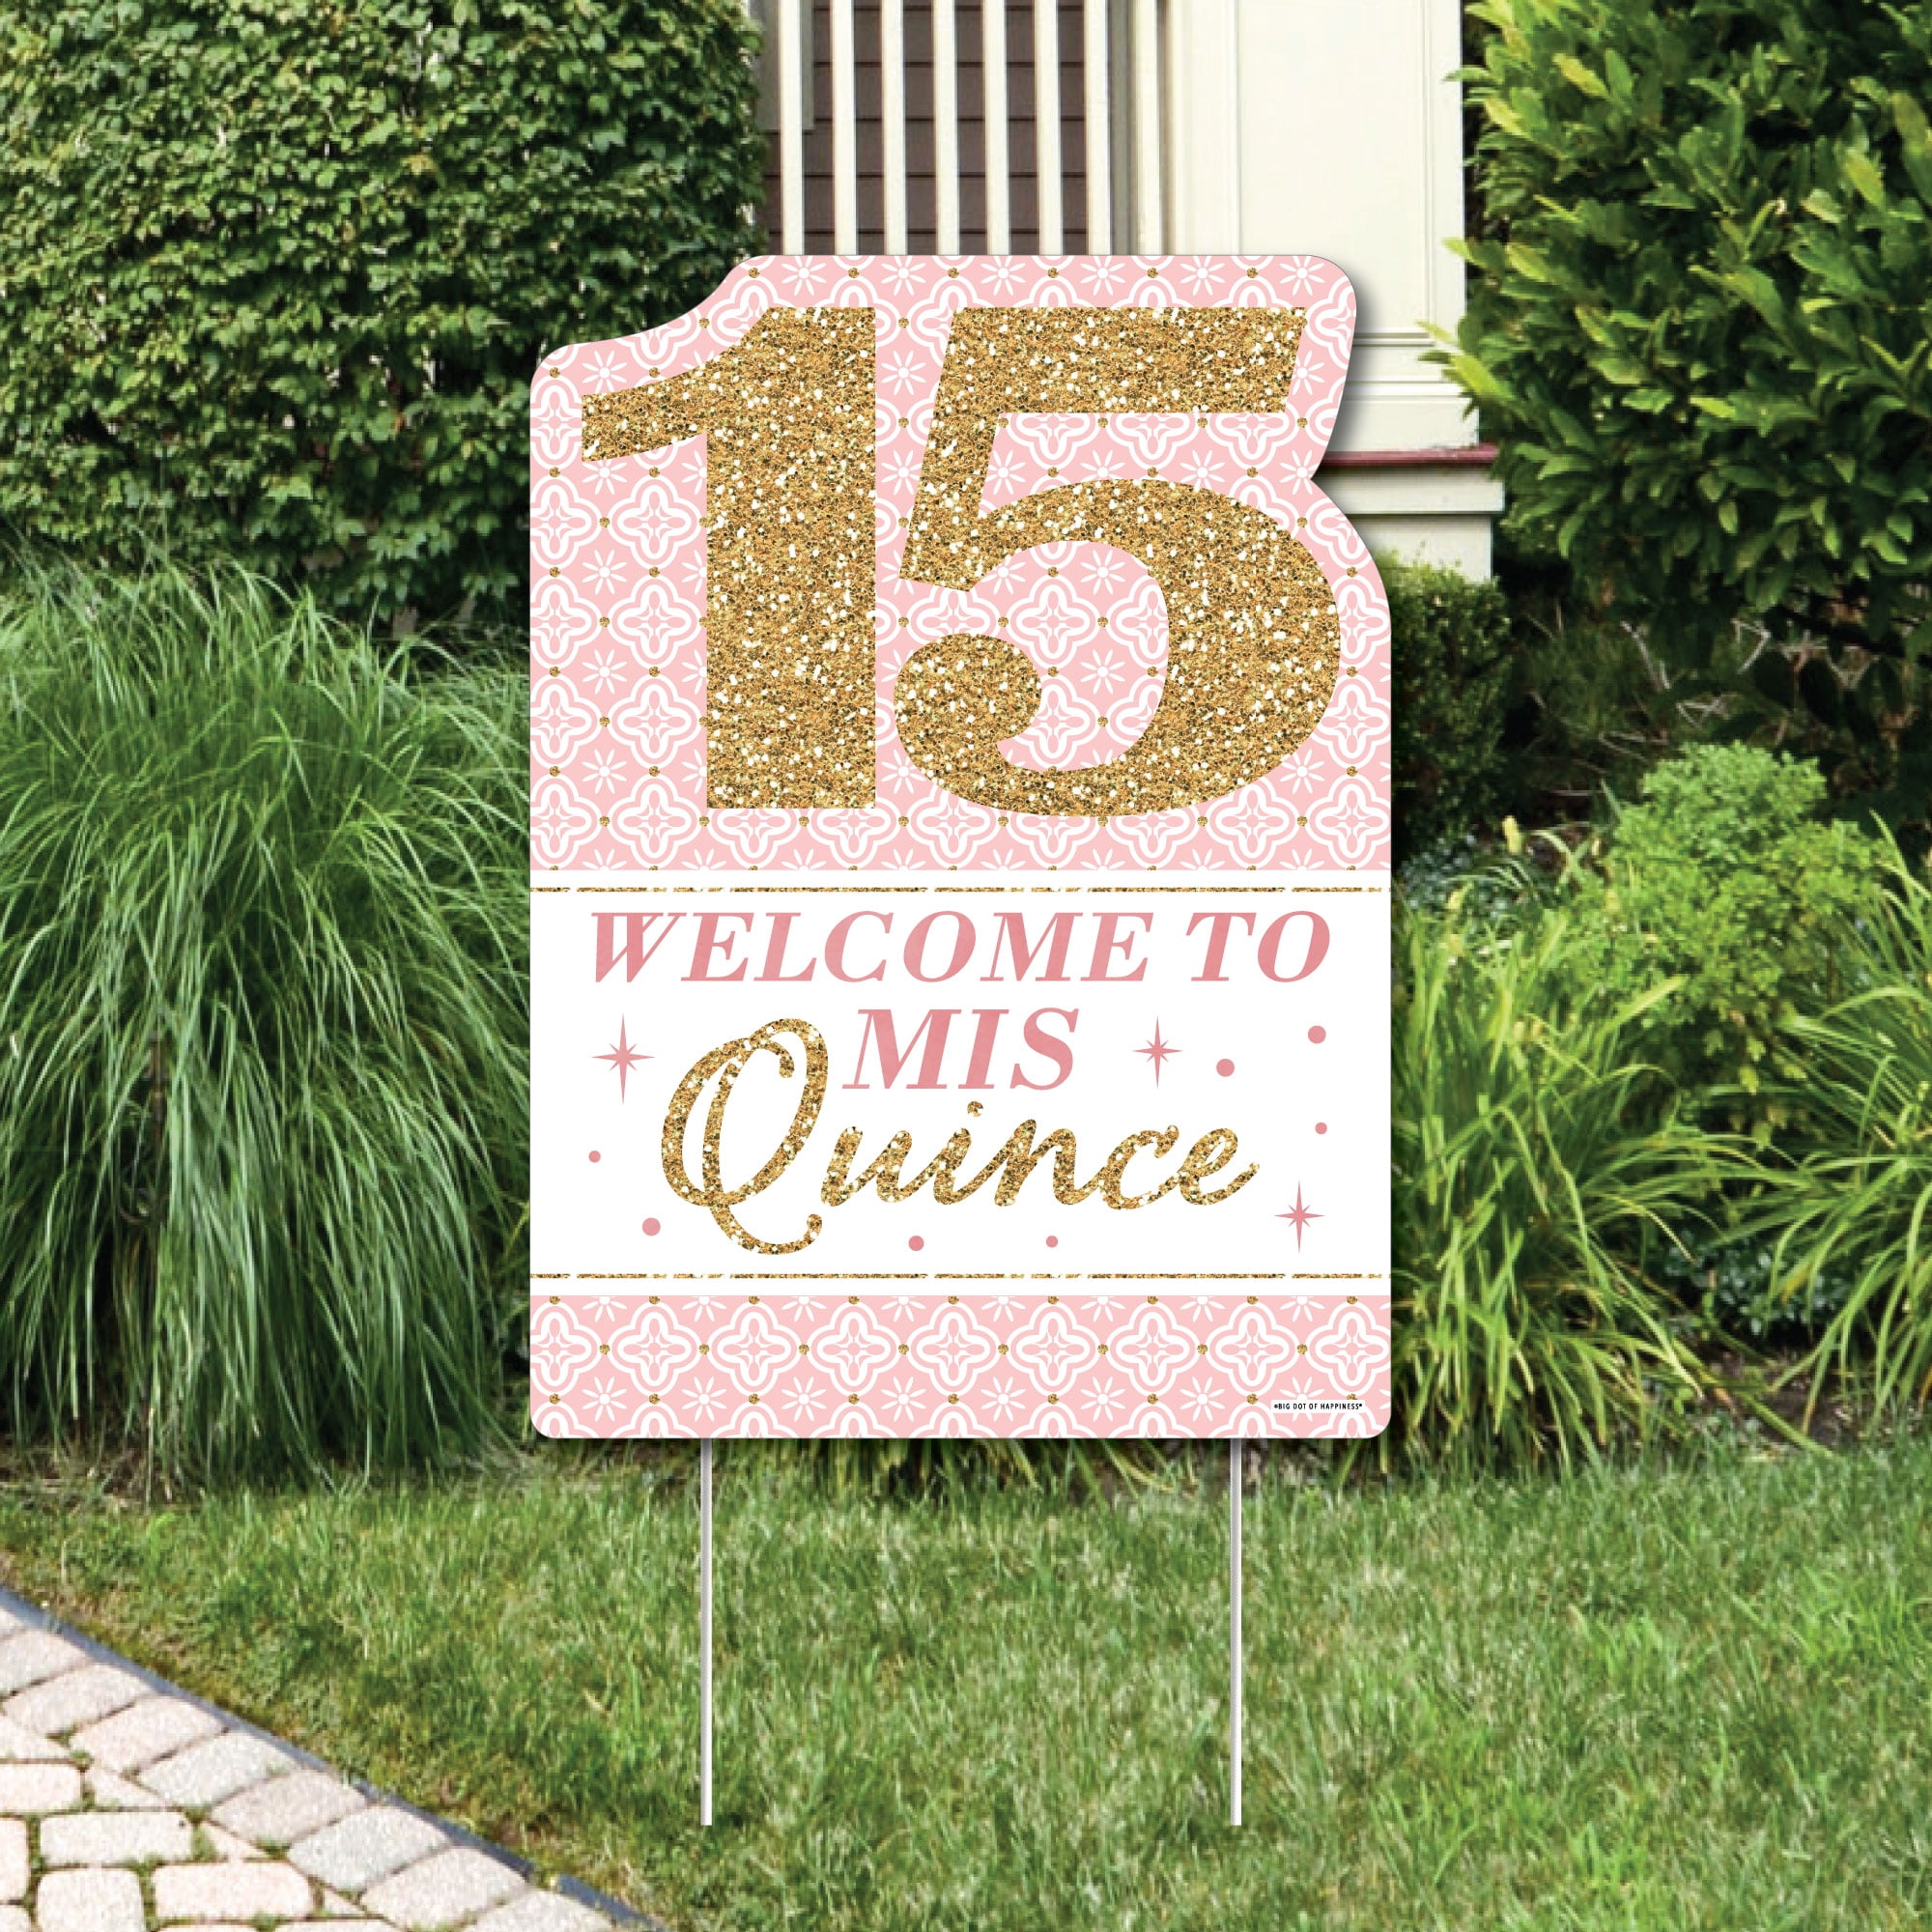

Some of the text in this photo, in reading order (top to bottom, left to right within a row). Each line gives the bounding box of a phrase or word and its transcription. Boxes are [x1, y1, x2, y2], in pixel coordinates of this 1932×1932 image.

[582, 306, 1341, 817] 15
[591, 910, 1331, 983] WELCOME TO
[842, 1007, 1080, 1092] MIS
[661, 1017, 1261, 1256] Quince
